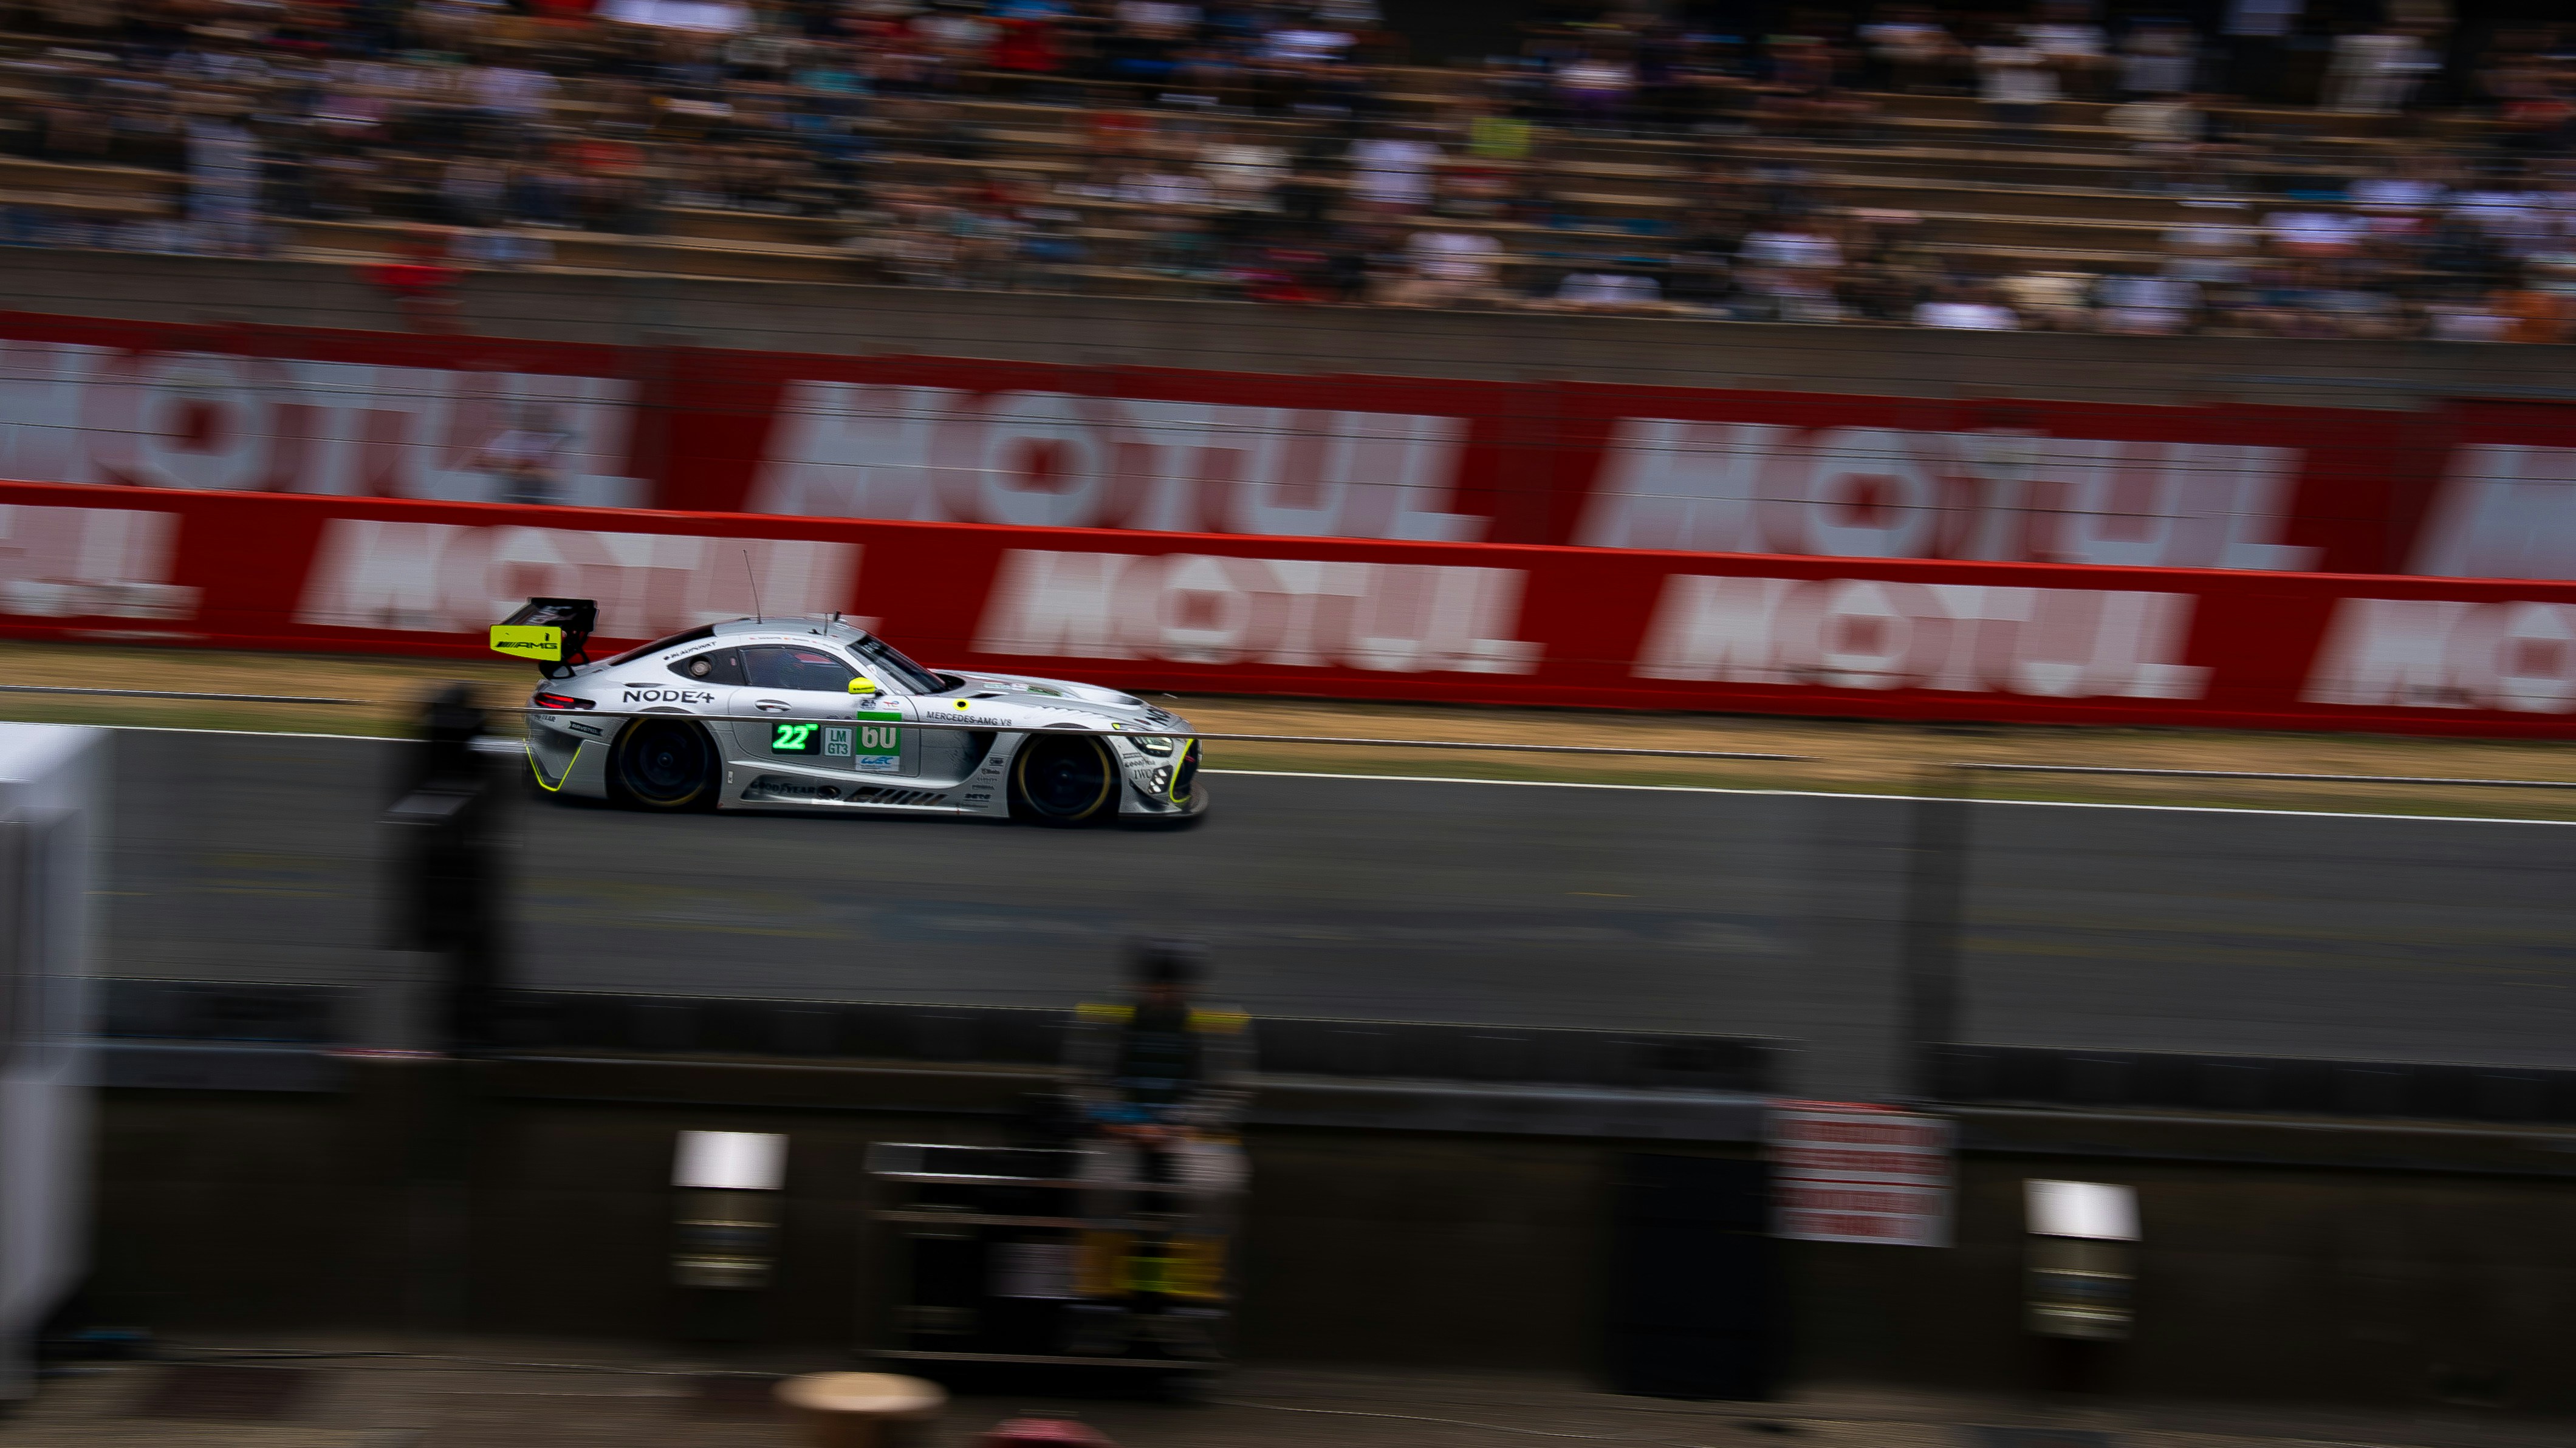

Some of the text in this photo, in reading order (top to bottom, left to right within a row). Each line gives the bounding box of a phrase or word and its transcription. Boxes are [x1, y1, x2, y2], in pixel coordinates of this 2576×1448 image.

[742, 378, 1494, 542] MOTUL
[1569, 416, 2324, 572] MOTUL
[516, 641, 558, 650] AMG
[966, 548, 1547, 675] MOTUL
[1629, 573, 2215, 700] MOTUL
[827, 743, 849, 755] GT3
[830, 729, 847, 743] LM
